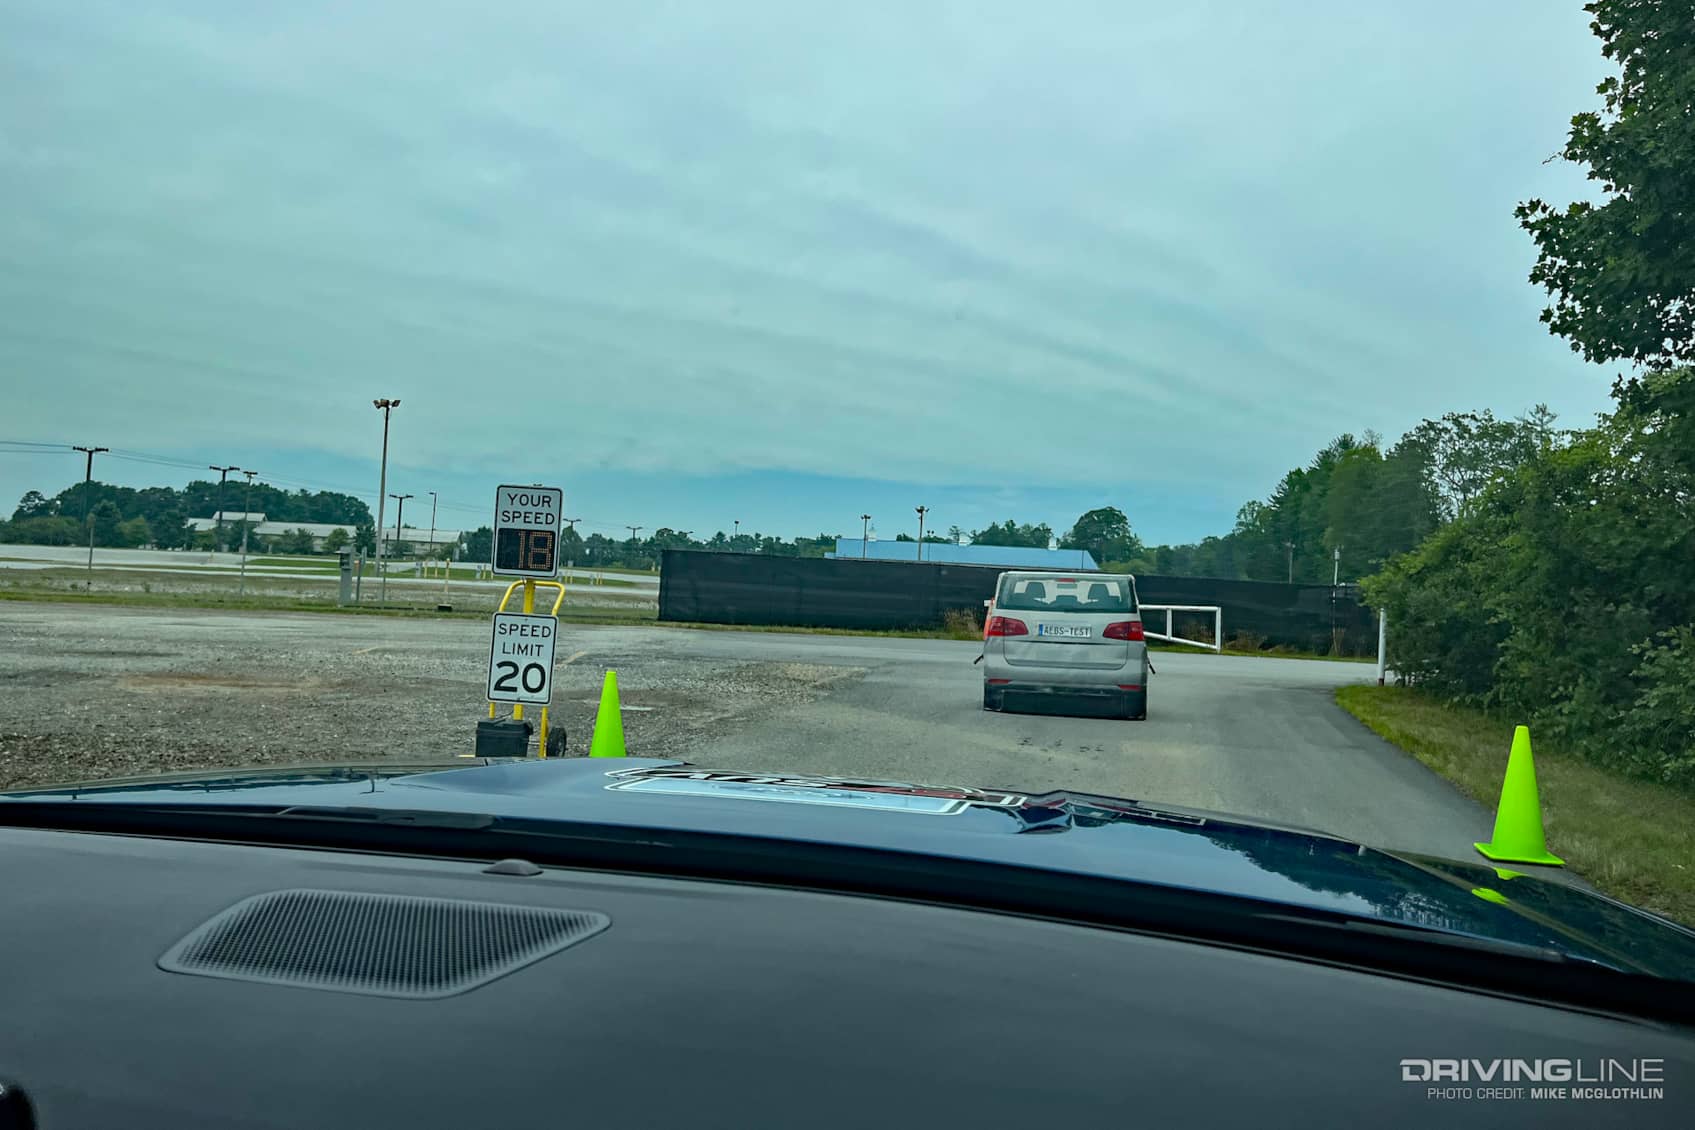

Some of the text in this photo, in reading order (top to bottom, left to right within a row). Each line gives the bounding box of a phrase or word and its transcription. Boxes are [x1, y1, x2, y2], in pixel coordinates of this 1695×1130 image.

[507, 493, 552, 508] YOUR
[501, 510, 555, 525] SPEED
[498, 623, 552, 638] SPEED
[502, 642, 545, 657] LIMIT
[493, 660, 546, 694] 20
